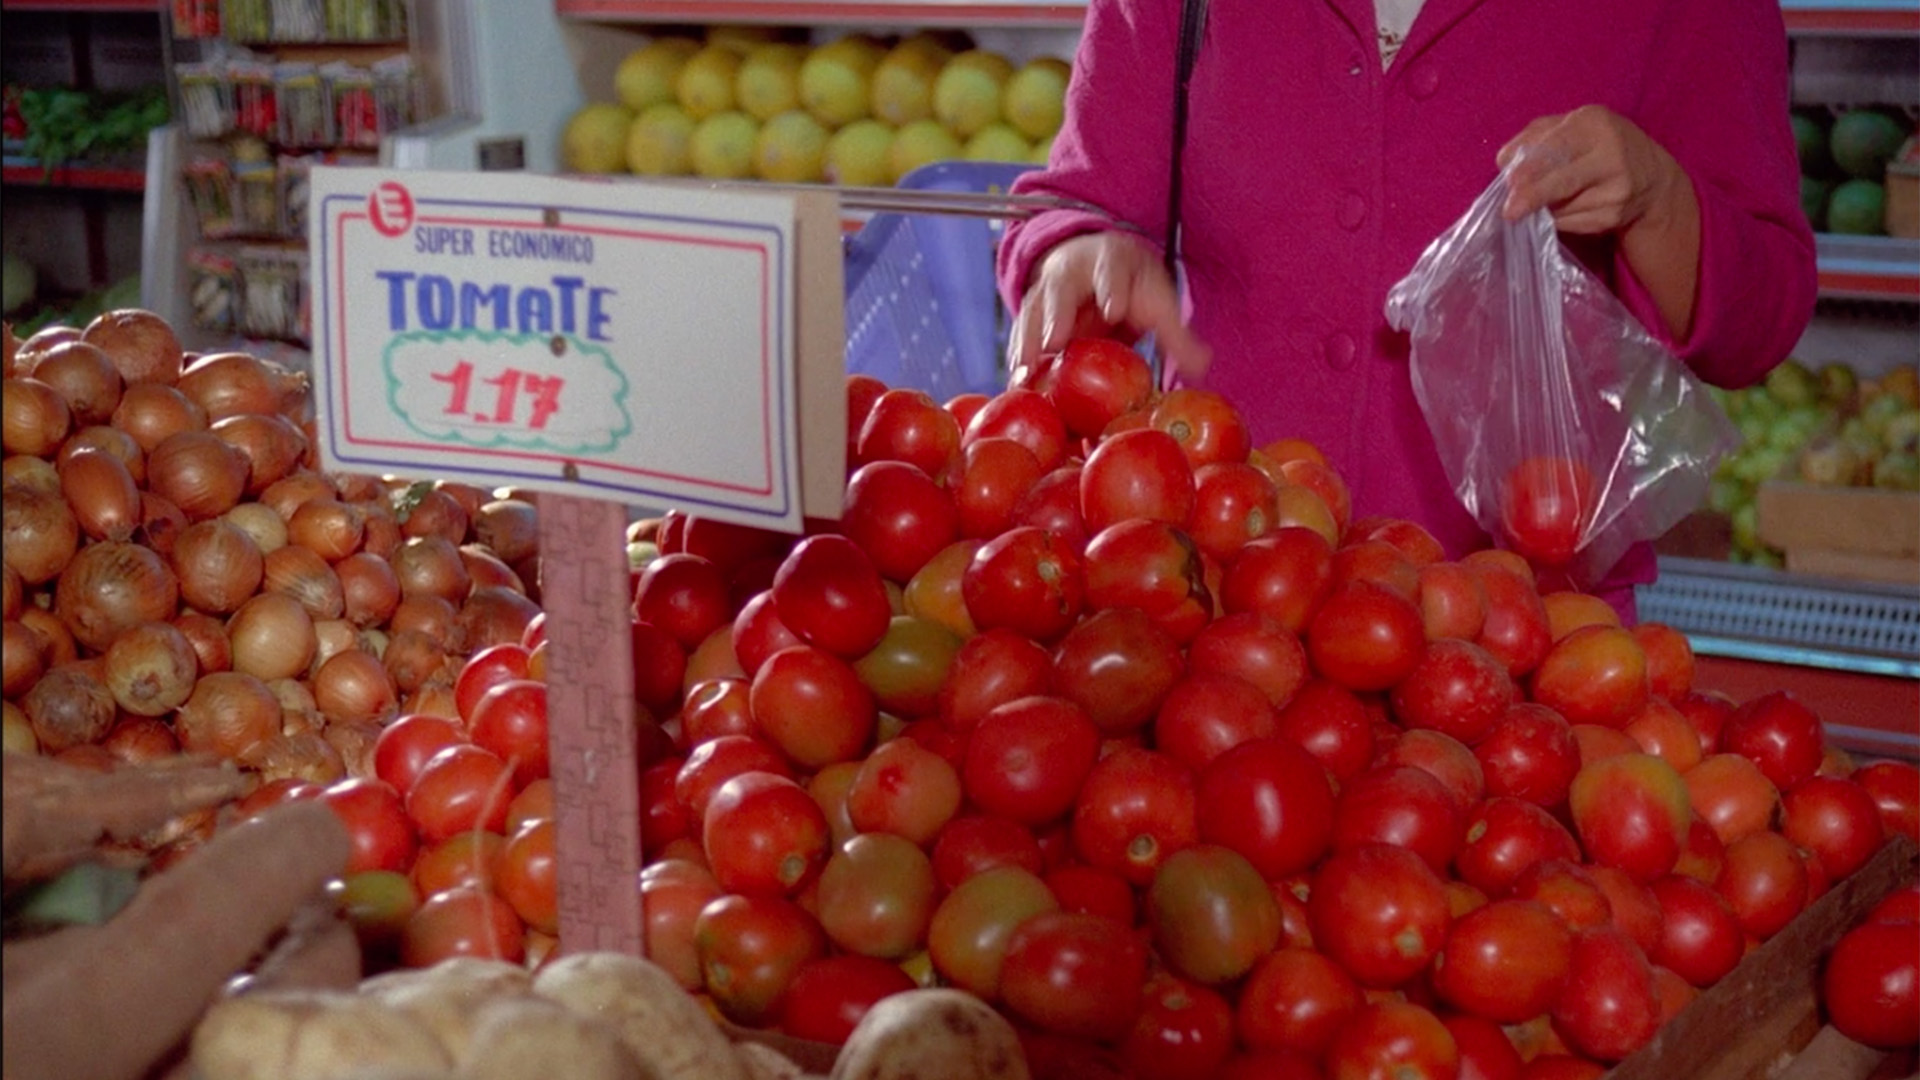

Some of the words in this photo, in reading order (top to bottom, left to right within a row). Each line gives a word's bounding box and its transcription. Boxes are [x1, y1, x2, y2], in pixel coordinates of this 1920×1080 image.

[415, 226, 474, 256] SUPER
[489, 229, 593, 264] ECONOMICO
[375, 270, 618, 342] TOMATE
[430, 360, 565, 429] 1.17
